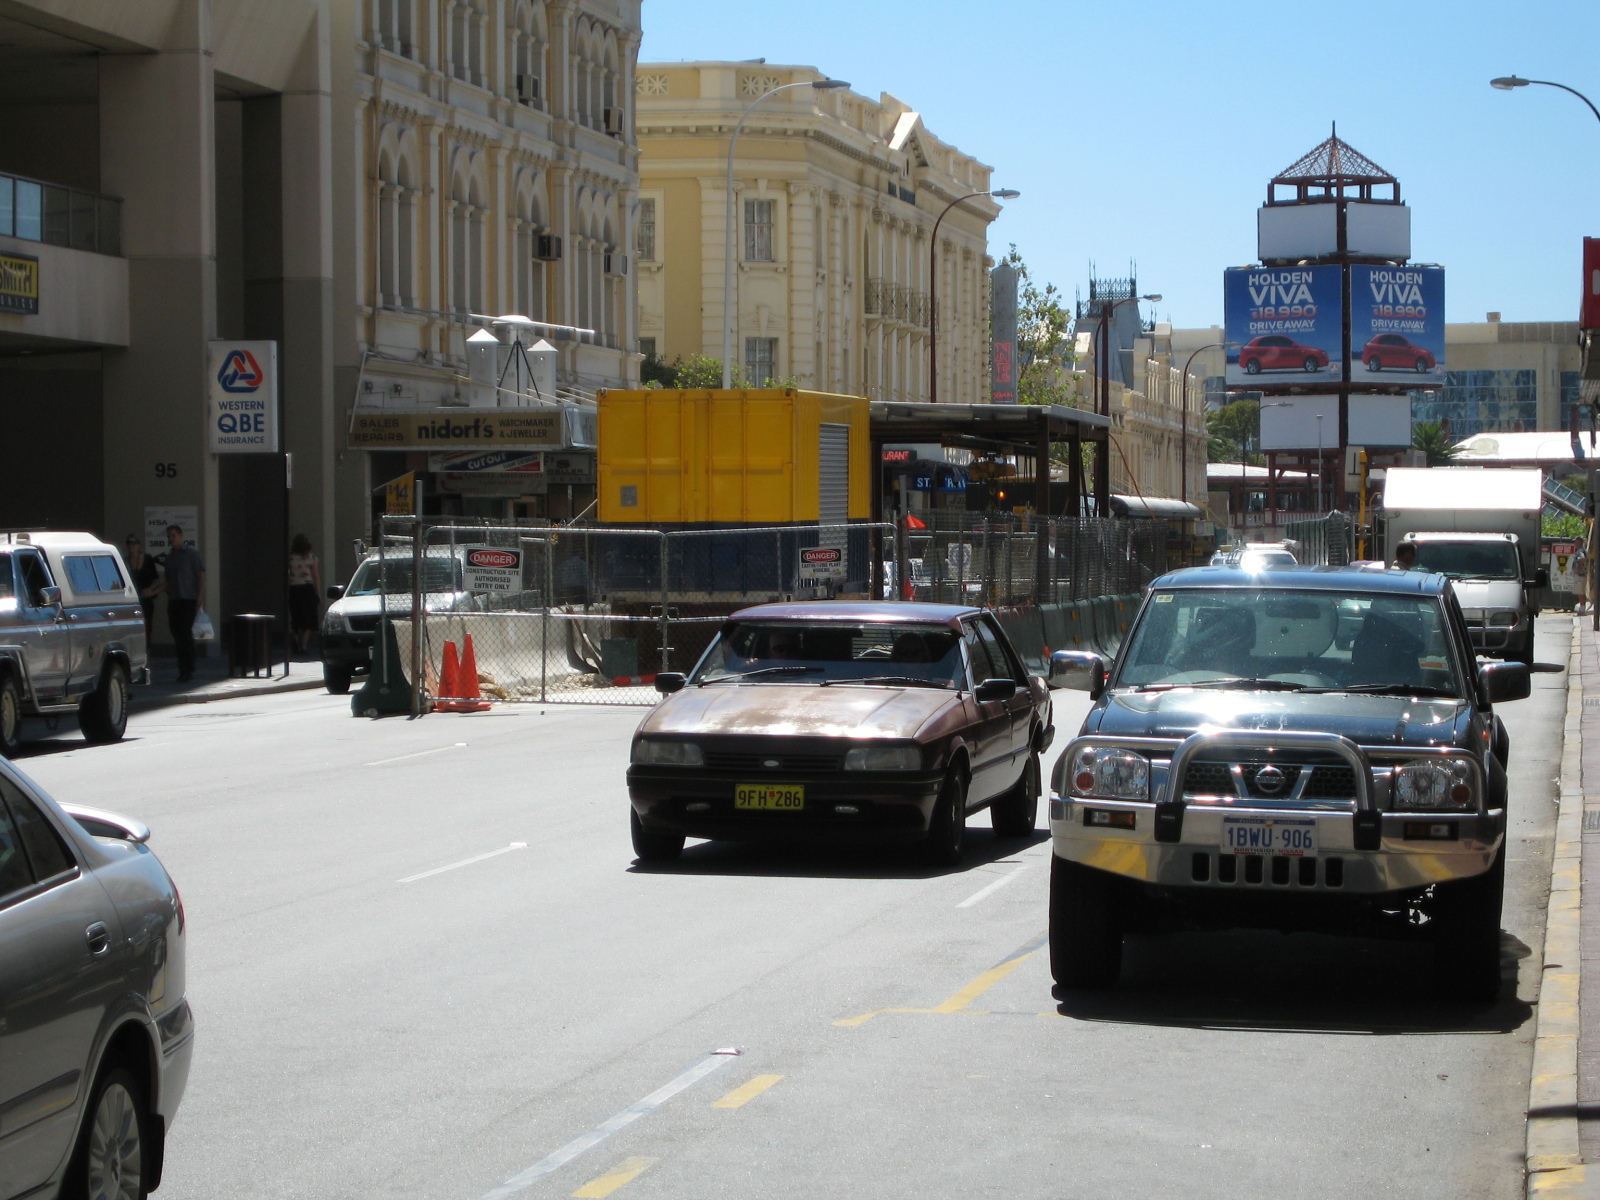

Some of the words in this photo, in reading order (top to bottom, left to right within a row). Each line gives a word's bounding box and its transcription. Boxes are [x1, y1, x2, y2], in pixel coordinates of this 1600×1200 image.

[1248, 271, 1313, 286] HOLDEN
[1370, 271, 1423, 284] HOLDEN
[1248, 284, 1314, 305] VIVA
[1370, 283, 1424, 304] VIVA
[218, 400, 264, 410] WESTERN
[217, 413, 264, 433] QBE
[359, 418, 399, 427] SALES
[499, 418, 554, 427] WATCHMAKER
[417, 418, 494, 439] nidorf's
[218, 435, 264, 444] INSURANCE
[354, 433, 404, 442] REPAIRS
[499, 430, 506, 438] &
[507, 430, 547, 439] JEWELLER
[467, 458, 485, 470] CUT
[486, 452, 507, 465] OUT
[155, 462, 177, 478] 95
[473, 554, 513, 564] DANGER
[466, 567, 506, 575] CONSTRUCTION
[474, 575, 511, 583] AUTHORISED
